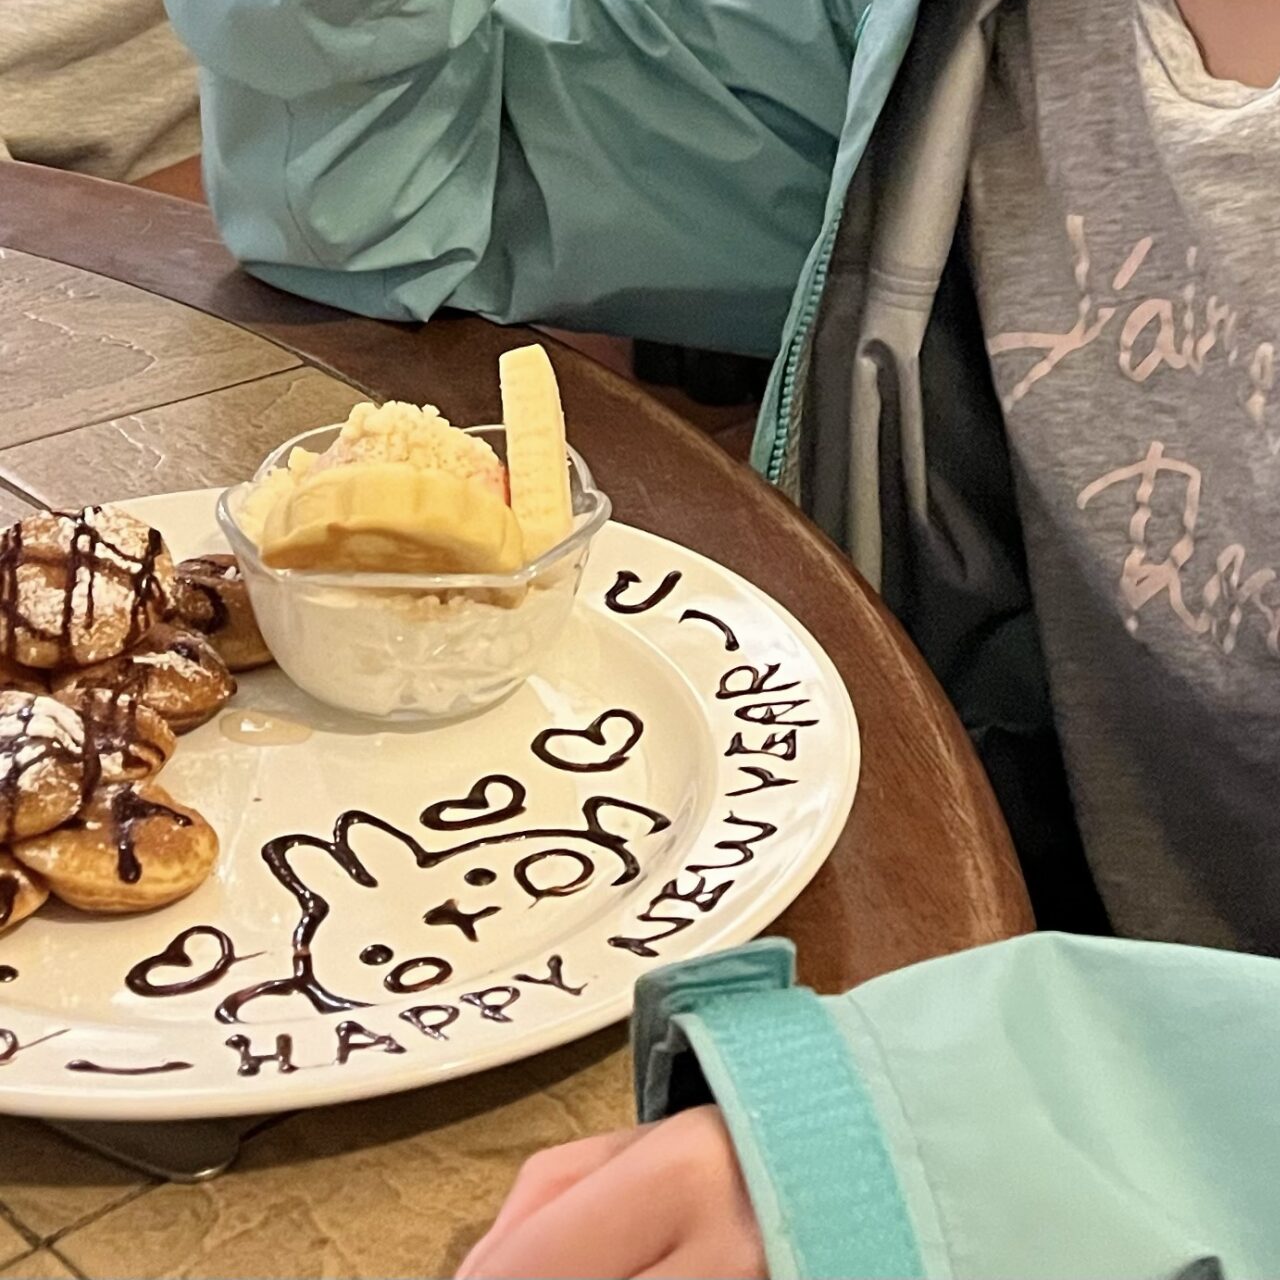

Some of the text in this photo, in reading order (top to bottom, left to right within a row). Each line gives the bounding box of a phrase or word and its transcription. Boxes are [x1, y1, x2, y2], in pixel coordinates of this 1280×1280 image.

[225, 662, 820, 1076] HAPPY NEW YEAR
